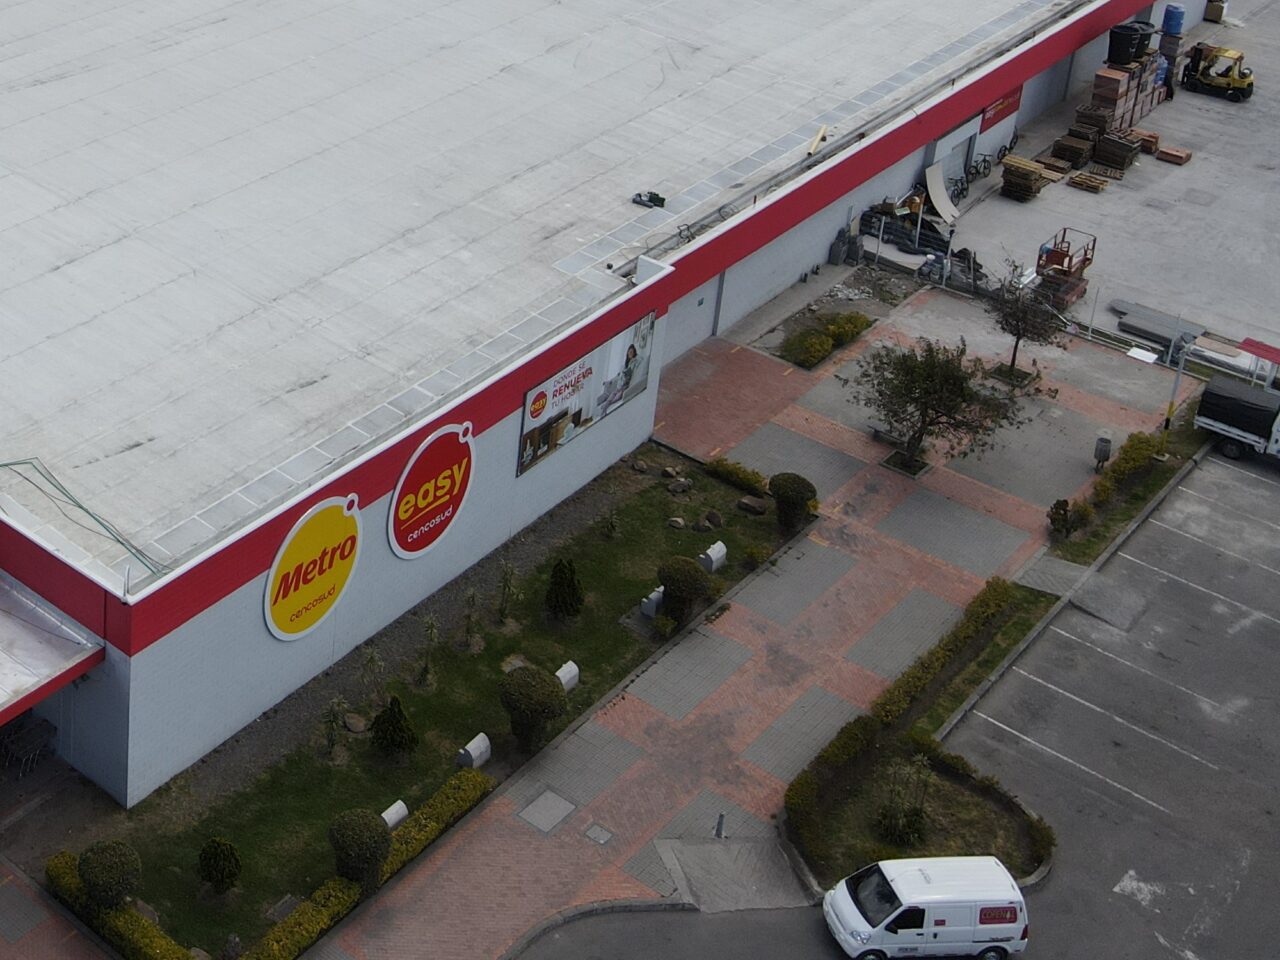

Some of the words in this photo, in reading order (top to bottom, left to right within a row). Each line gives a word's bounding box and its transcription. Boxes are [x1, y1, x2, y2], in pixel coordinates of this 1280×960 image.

[552, 367, 593, 399] RENUEVA
[553, 368, 577, 388] DONDE
[398, 456, 469, 521] easy
[407, 504, 453, 543] cencosud
[272, 534, 357, 607] Metro
[289, 584, 336, 623] cencosud
